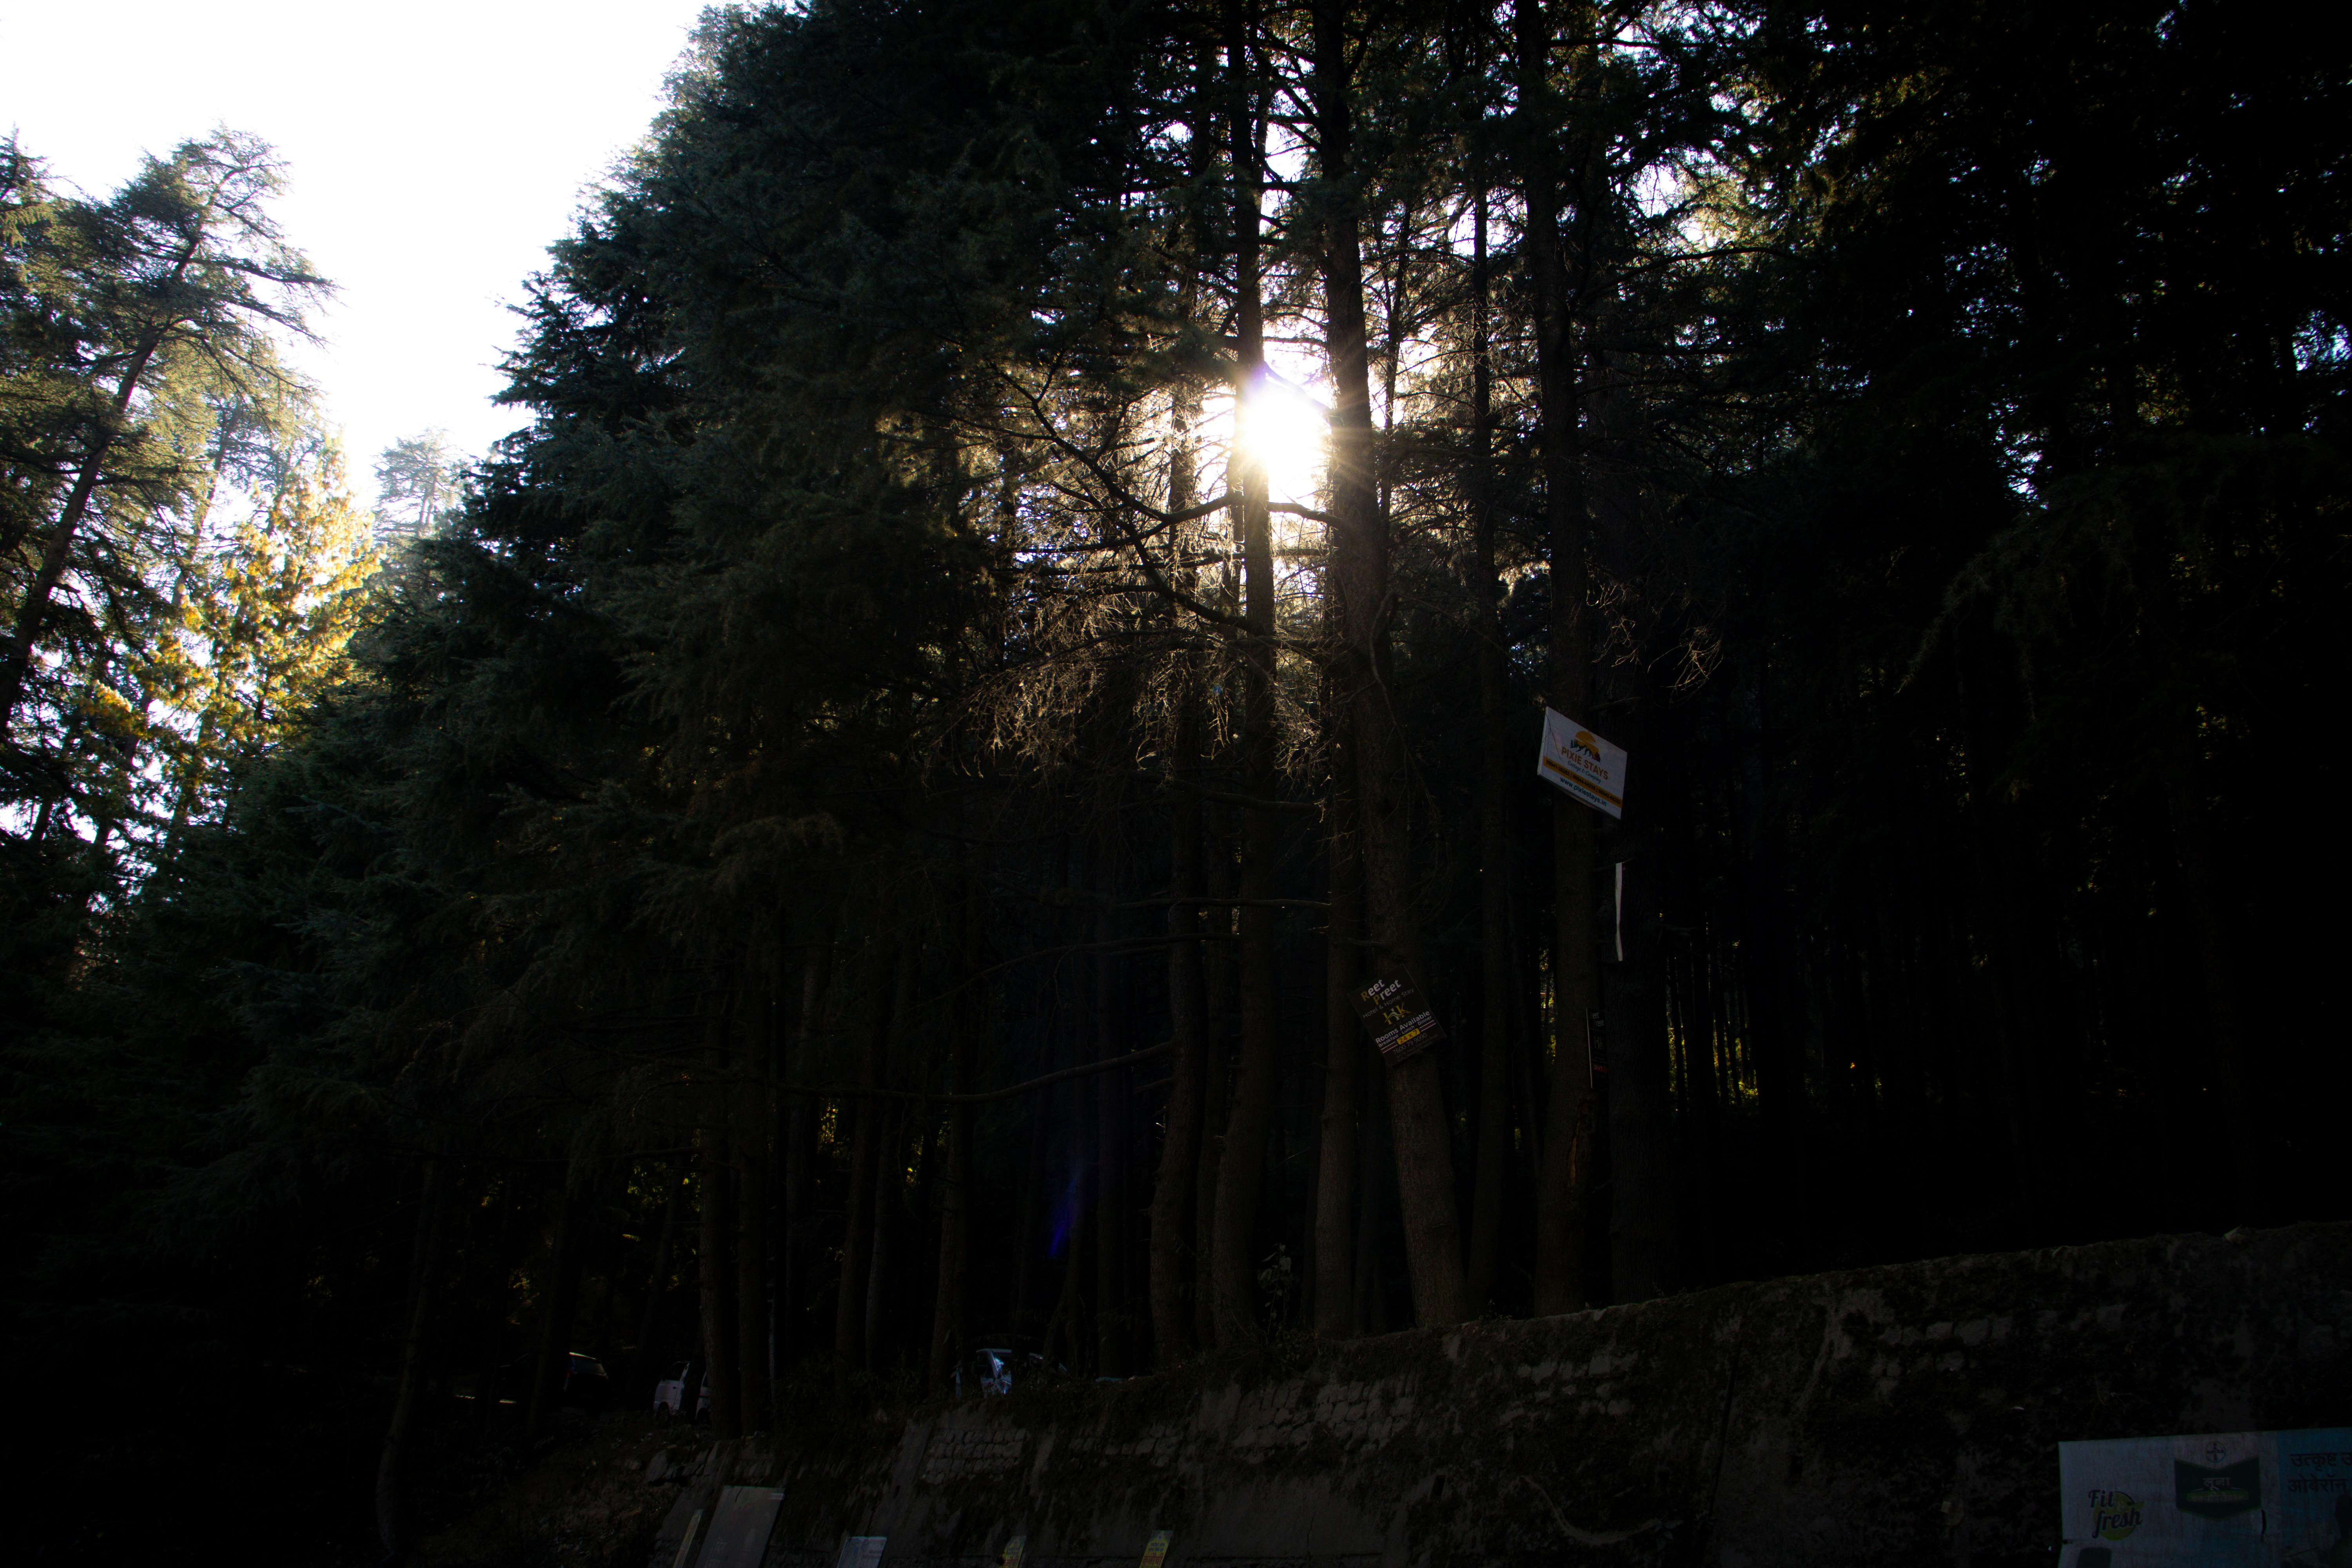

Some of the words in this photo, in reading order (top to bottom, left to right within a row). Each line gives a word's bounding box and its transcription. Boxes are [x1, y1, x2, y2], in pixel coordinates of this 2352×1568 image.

[1561, 746, 1581, 765] PIXIE
[1584, 759, 1608, 780] STAYS
[1568, 760, 1581, 772] Cottage
[1586, 771, 1601, 784] Camping
[1560, 778, 1606, 806] www.pixiestays.in
[1361, 979, 1385, 1001] Reet
[1363, 1007, 1378, 1018] Hotel
[1384, 995, 1401, 1007] Home
[1401, 987, 1414, 997] Stay
[1373, 979, 1401, 1005] Preet
[1375, 1028, 1398, 1043] Rooms
[1399, 1011, 1430, 1031] Available
[1378, 1035, 1398, 1047] Breakfast
[1401, 1025, 1415, 1034] Lunch
[1417, 1016, 1432, 1025] Dinner
[1393, 1044, 1406, 1054] 7600
[1414, 1033, 1427, 1043] 9090
[2290, 1453, 2338, 1471] उत्कृष्ट
[2203, 1477, 2232, 1491] लूना
[2288, 1473, 2348, 1493] ओबेरॉन
[2088, 1490, 2116, 1508] Fit
[2092, 1507, 2143, 1539] fresh
